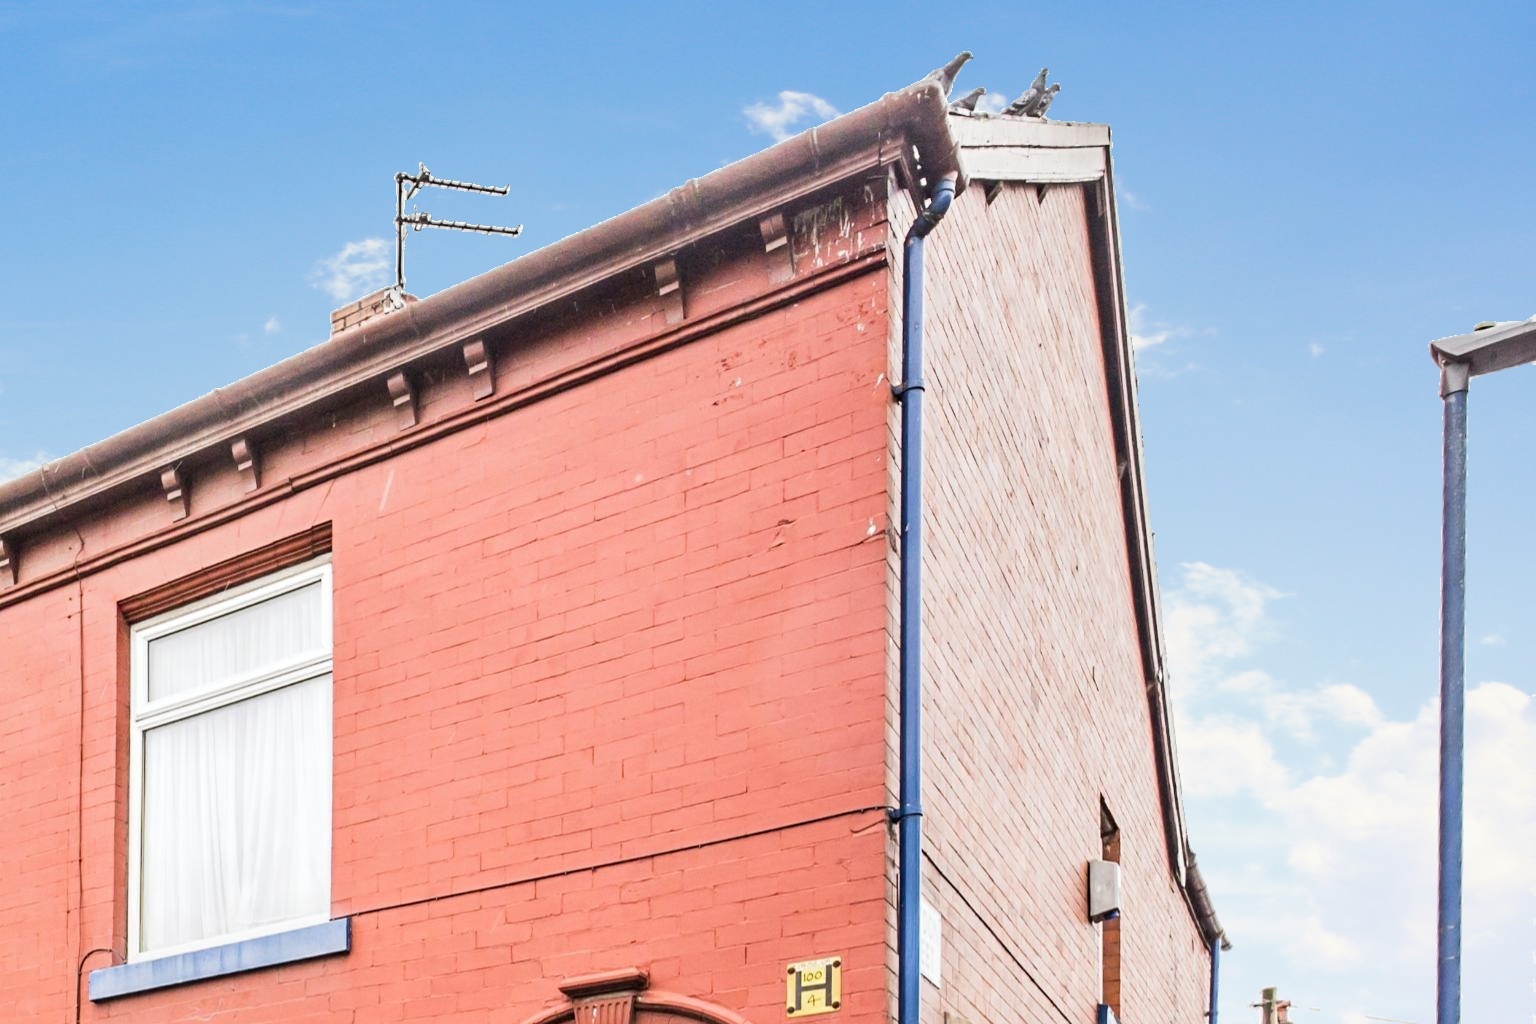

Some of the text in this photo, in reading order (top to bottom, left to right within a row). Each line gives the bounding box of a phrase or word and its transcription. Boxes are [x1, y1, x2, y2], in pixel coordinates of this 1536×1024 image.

[803, 970, 822, 982] 100
[795, 964, 832, 1011] H
[807, 994, 821, 1007] 4
